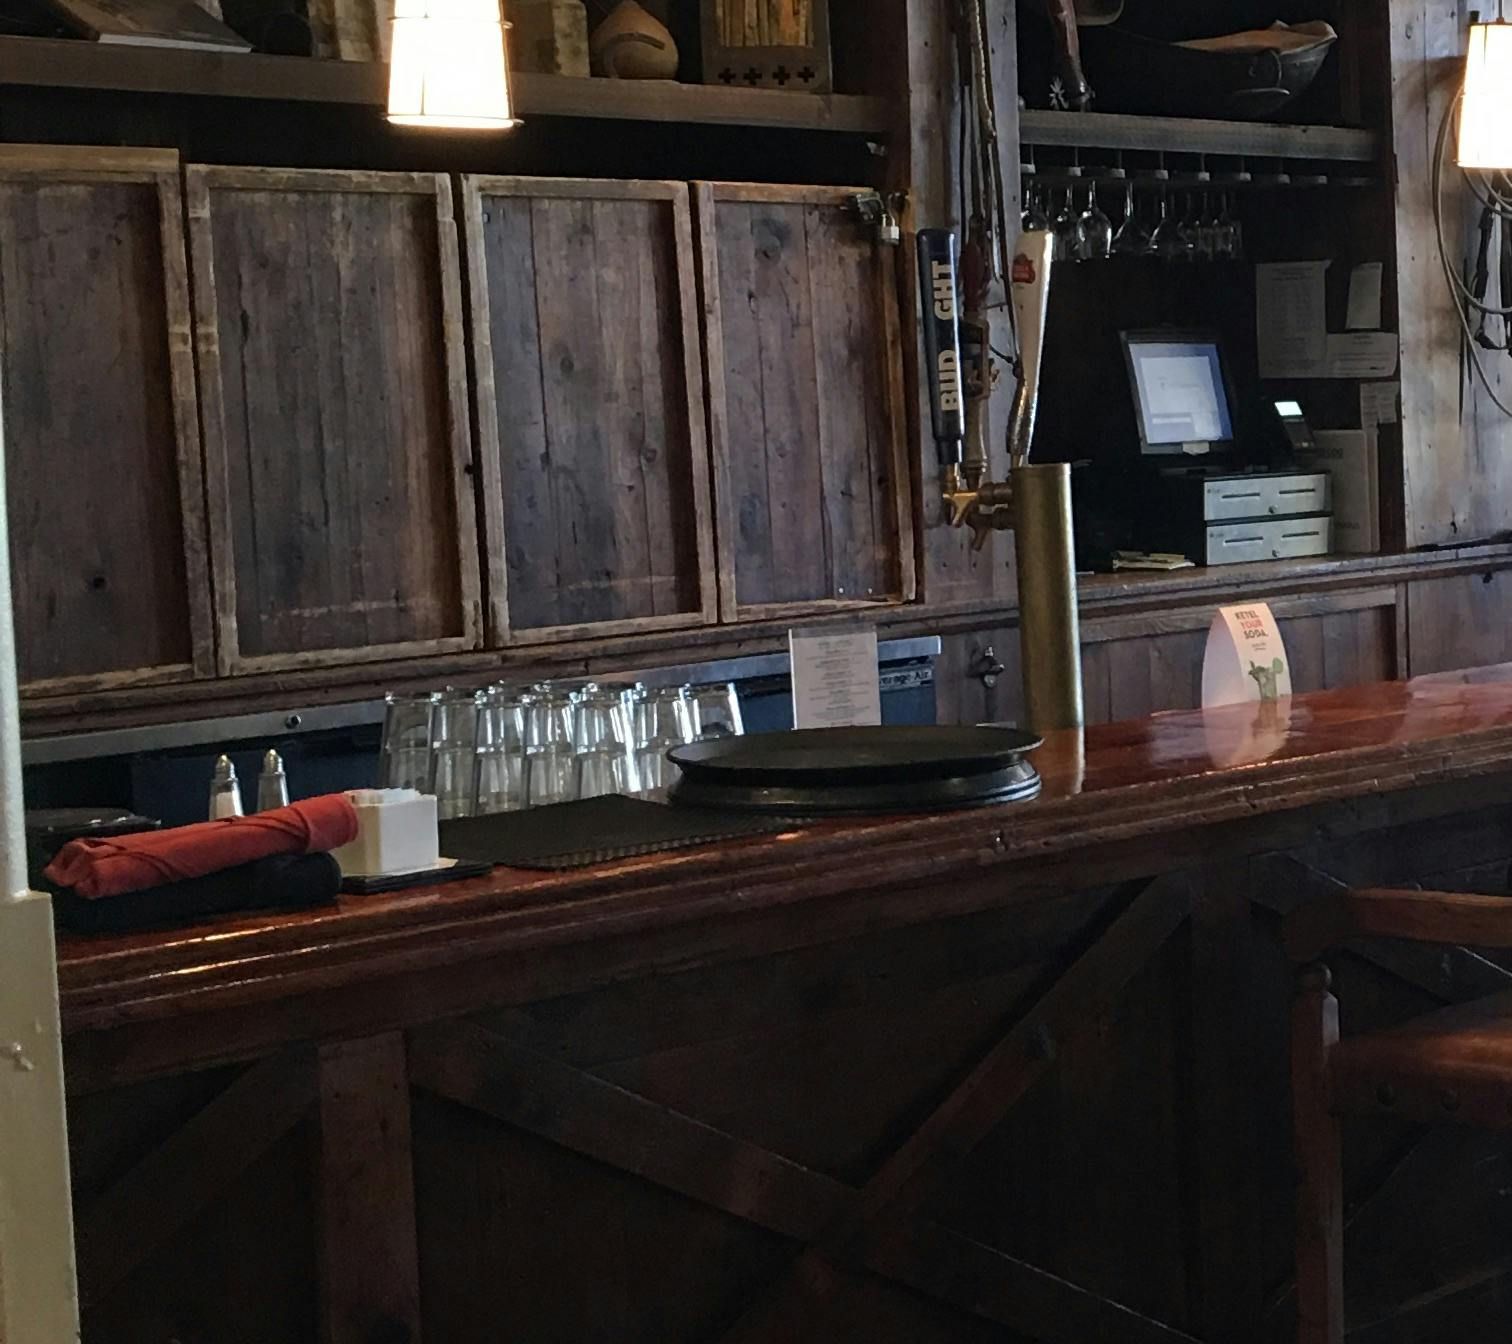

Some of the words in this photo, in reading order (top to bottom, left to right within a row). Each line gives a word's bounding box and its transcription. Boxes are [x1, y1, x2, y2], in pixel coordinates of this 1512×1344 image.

[931, 261, 956, 320] GHT
[939, 350, 962, 411] BUD
[1235, 610, 1259, 619] KETEL
[1240, 619, 1263, 629] YOUR
[914, 671, 929, 680] Air
